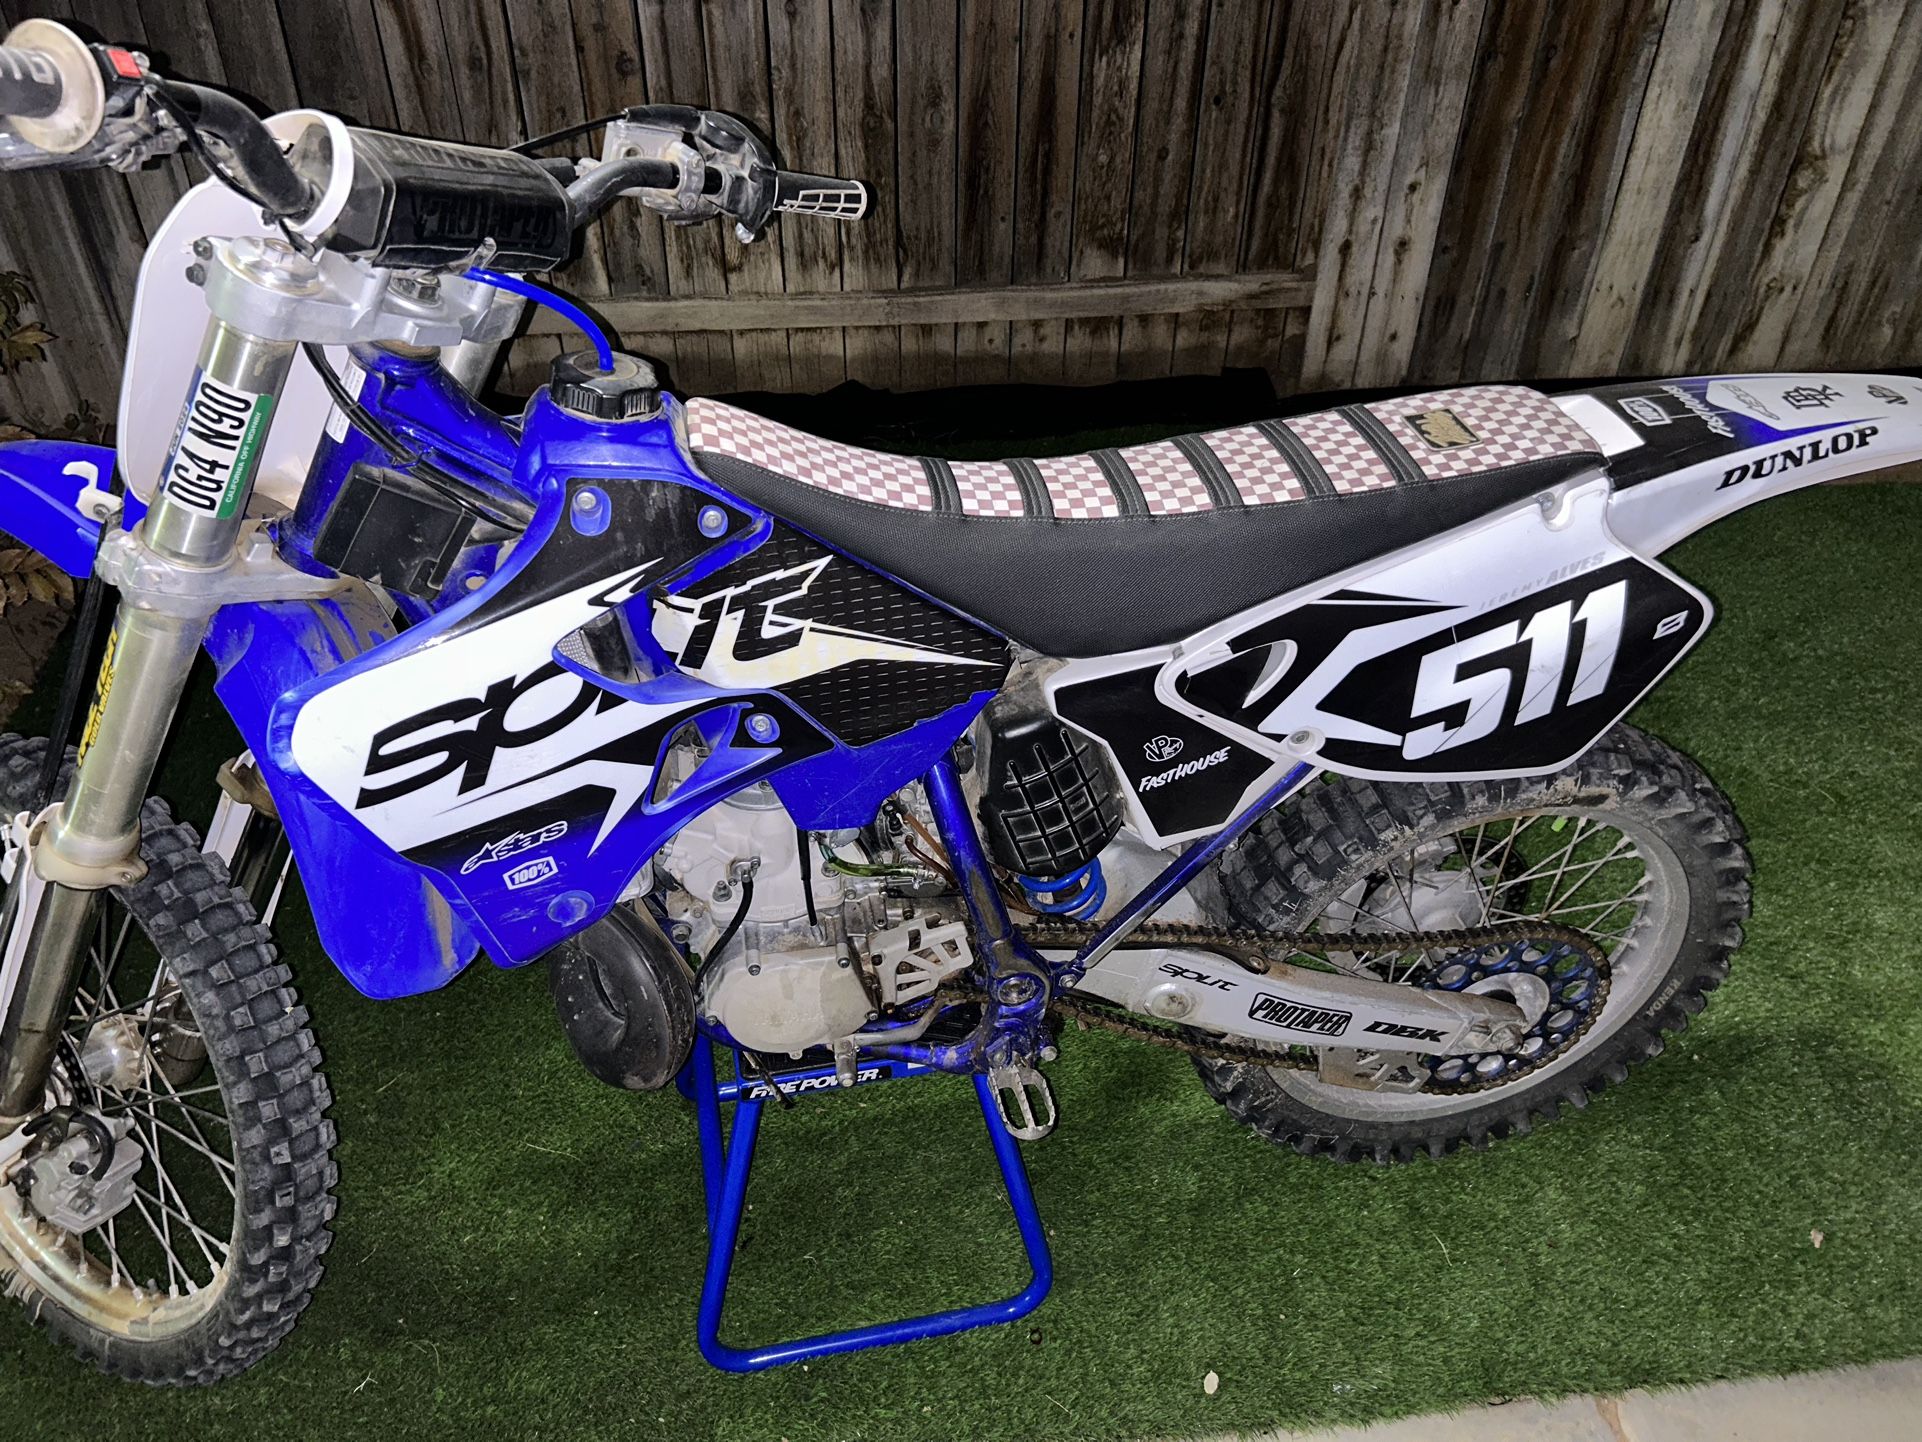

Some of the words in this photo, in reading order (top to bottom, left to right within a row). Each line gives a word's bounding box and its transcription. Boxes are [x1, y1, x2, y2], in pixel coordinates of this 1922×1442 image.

[187, 381, 253, 452] N90
[166, 445, 231, 512] DG4
[225, 461, 245, 503] CALIFORNIA
[240, 446, 249, 460] OFF
[246, 411, 263, 443] HIGHWAY
[1714, 426, 1880, 492] DUNLOP
[1545, 551, 1606, 585] ALVES
[1402, 579, 1629, 761] 511
[1138, 746, 1231, 793] FASTHOUSE
[511, 860, 551, 886] 100%
[1255, 996, 1349, 1036] PROTAPER
[1646, 978, 1682, 1017] KENDA
[1362, 1020, 1451, 1043] DBK
